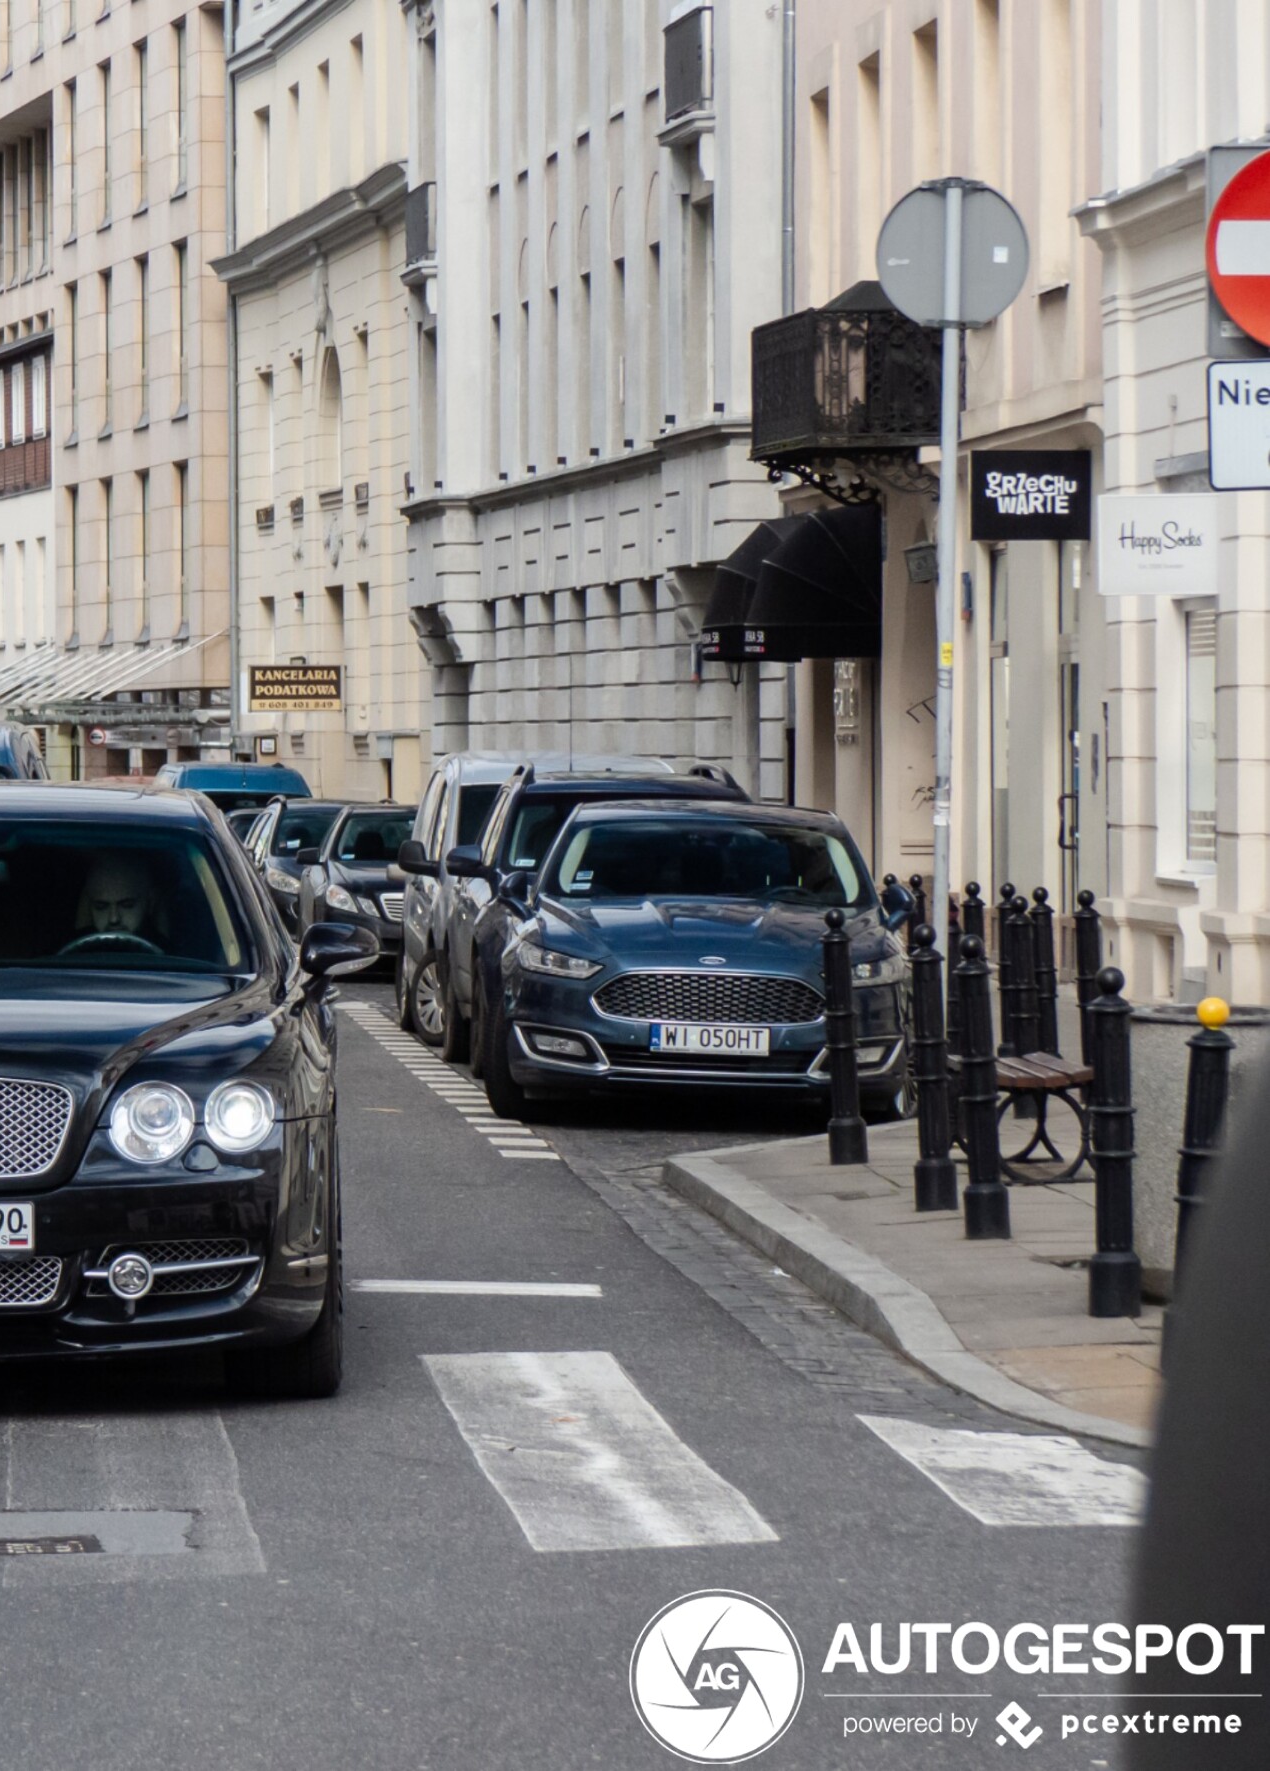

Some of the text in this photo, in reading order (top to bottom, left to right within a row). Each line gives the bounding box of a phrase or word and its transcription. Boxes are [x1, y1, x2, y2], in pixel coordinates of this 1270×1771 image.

[1218, 379, 1270, 406] Nie
[997, 492, 1069, 515] WARTE
[1118, 520, 1203, 555] Happy Socks
[254, 670, 337, 681] KANCELARIA
[255, 685, 337, 696] PODATKOWA
[666, 1027, 764, 1050] WI 050HT
